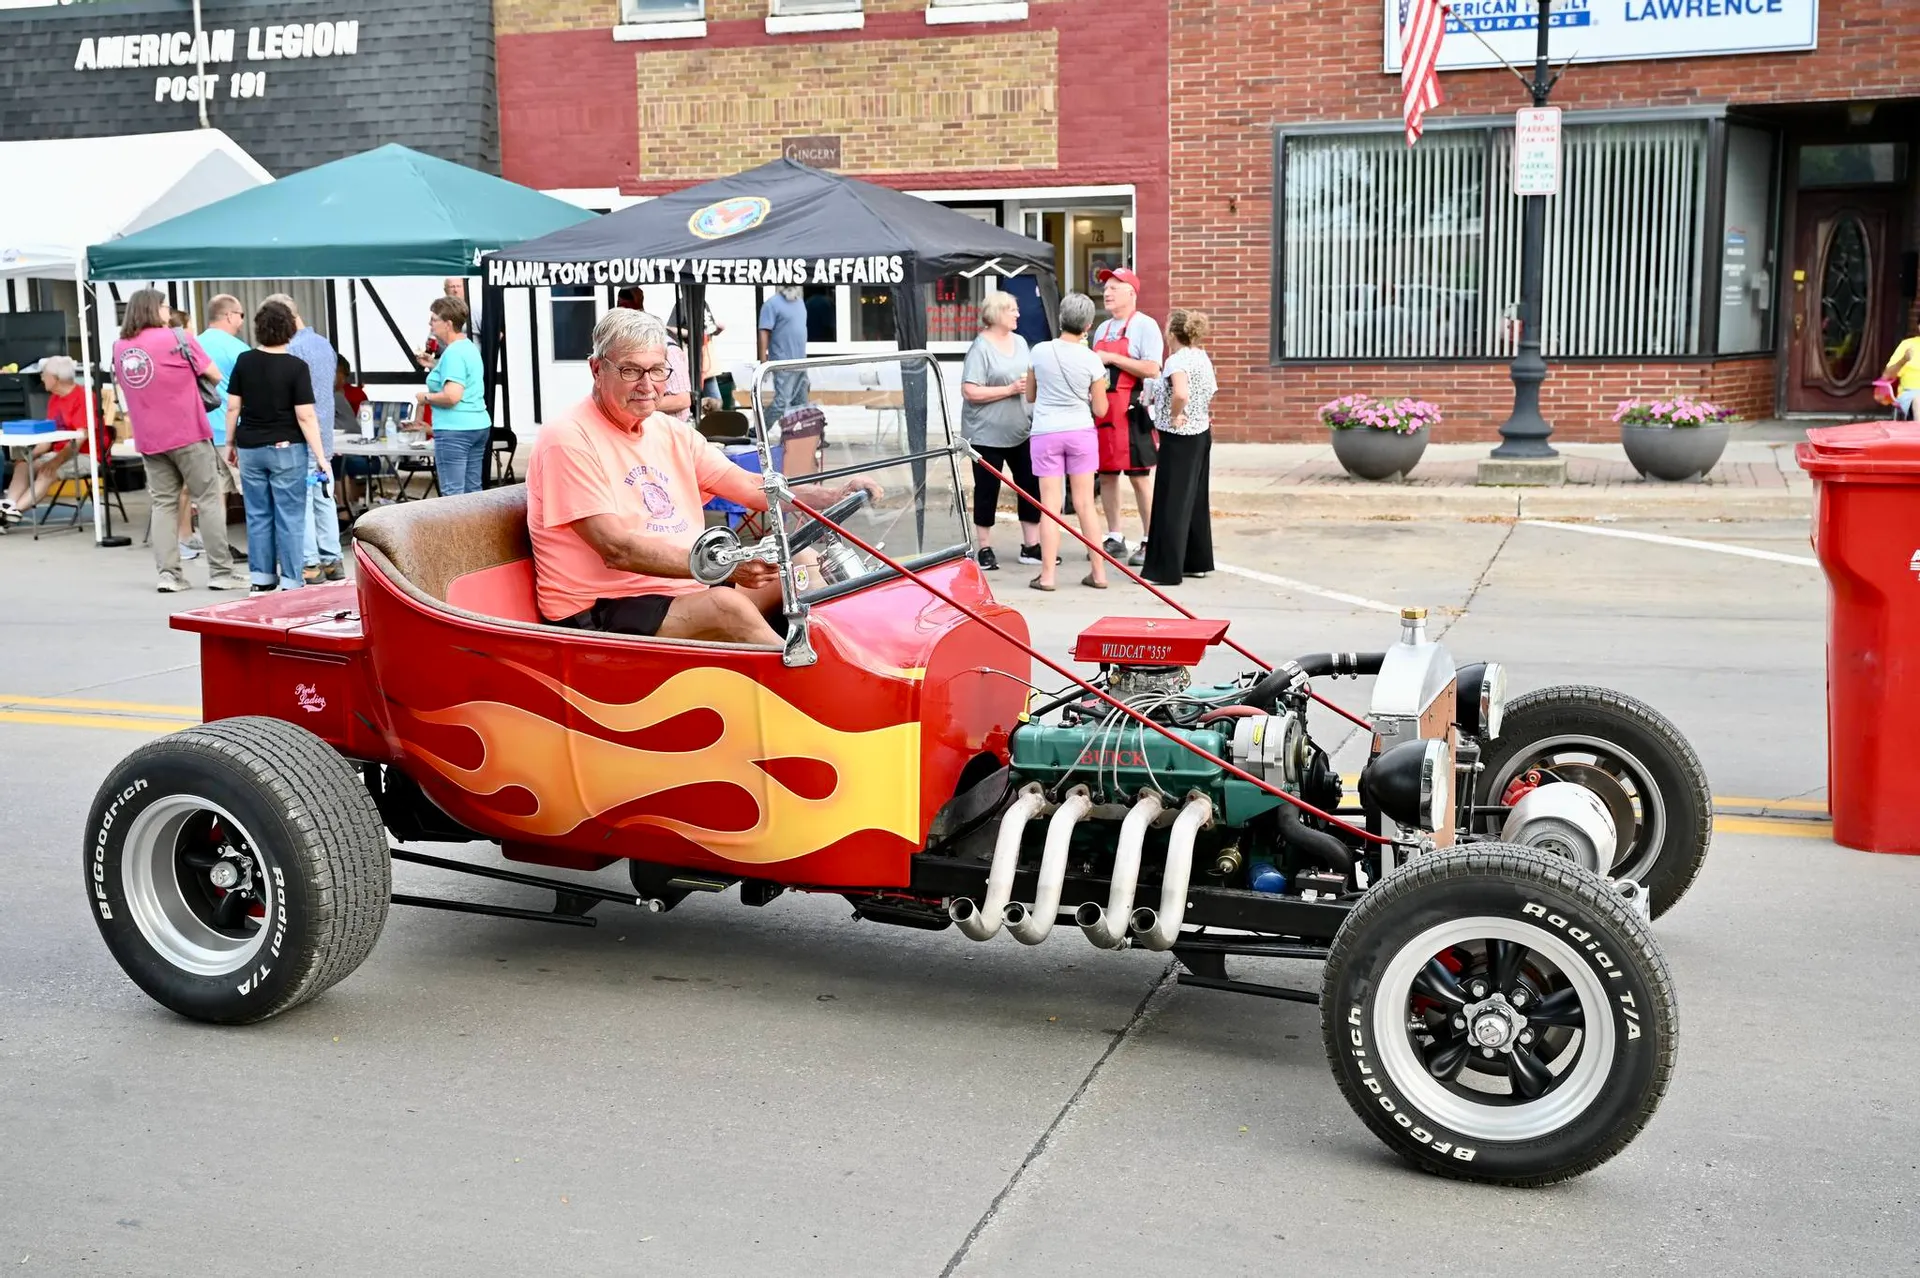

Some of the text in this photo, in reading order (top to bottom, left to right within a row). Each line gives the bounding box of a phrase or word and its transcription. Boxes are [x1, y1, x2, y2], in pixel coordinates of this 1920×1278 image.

[1446, 1, 1517, 17] ERICAN
[1625, 0, 1783, 22] LAWRENCE
[1446, 13, 1578, 32] NSURANCE
[75, 20, 359, 71] AMERICAN LEGION
[155, 71, 266, 102] POST 191
[1521, 125, 1556, 133] PARKING
[488, 255, 904, 286] HAMILTON COUNTY VETERANS AFFAIRS
[646, 522, 671, 533] FORT
[1102, 643, 1172, 660] WILDCAT "355"
[294, 683, 316, 695] Pink
[298, 693, 327, 708] Ladies
[1080, 750, 1147, 767] BUICK
[93, 778, 149, 920] BFGoodrich
[270, 866, 287, 958] Radial
[1522, 902, 1623, 978] Radial
[1620, 990, 1641, 1040] T/A
[1348, 1007, 1477, 1162] BFGoodrich
